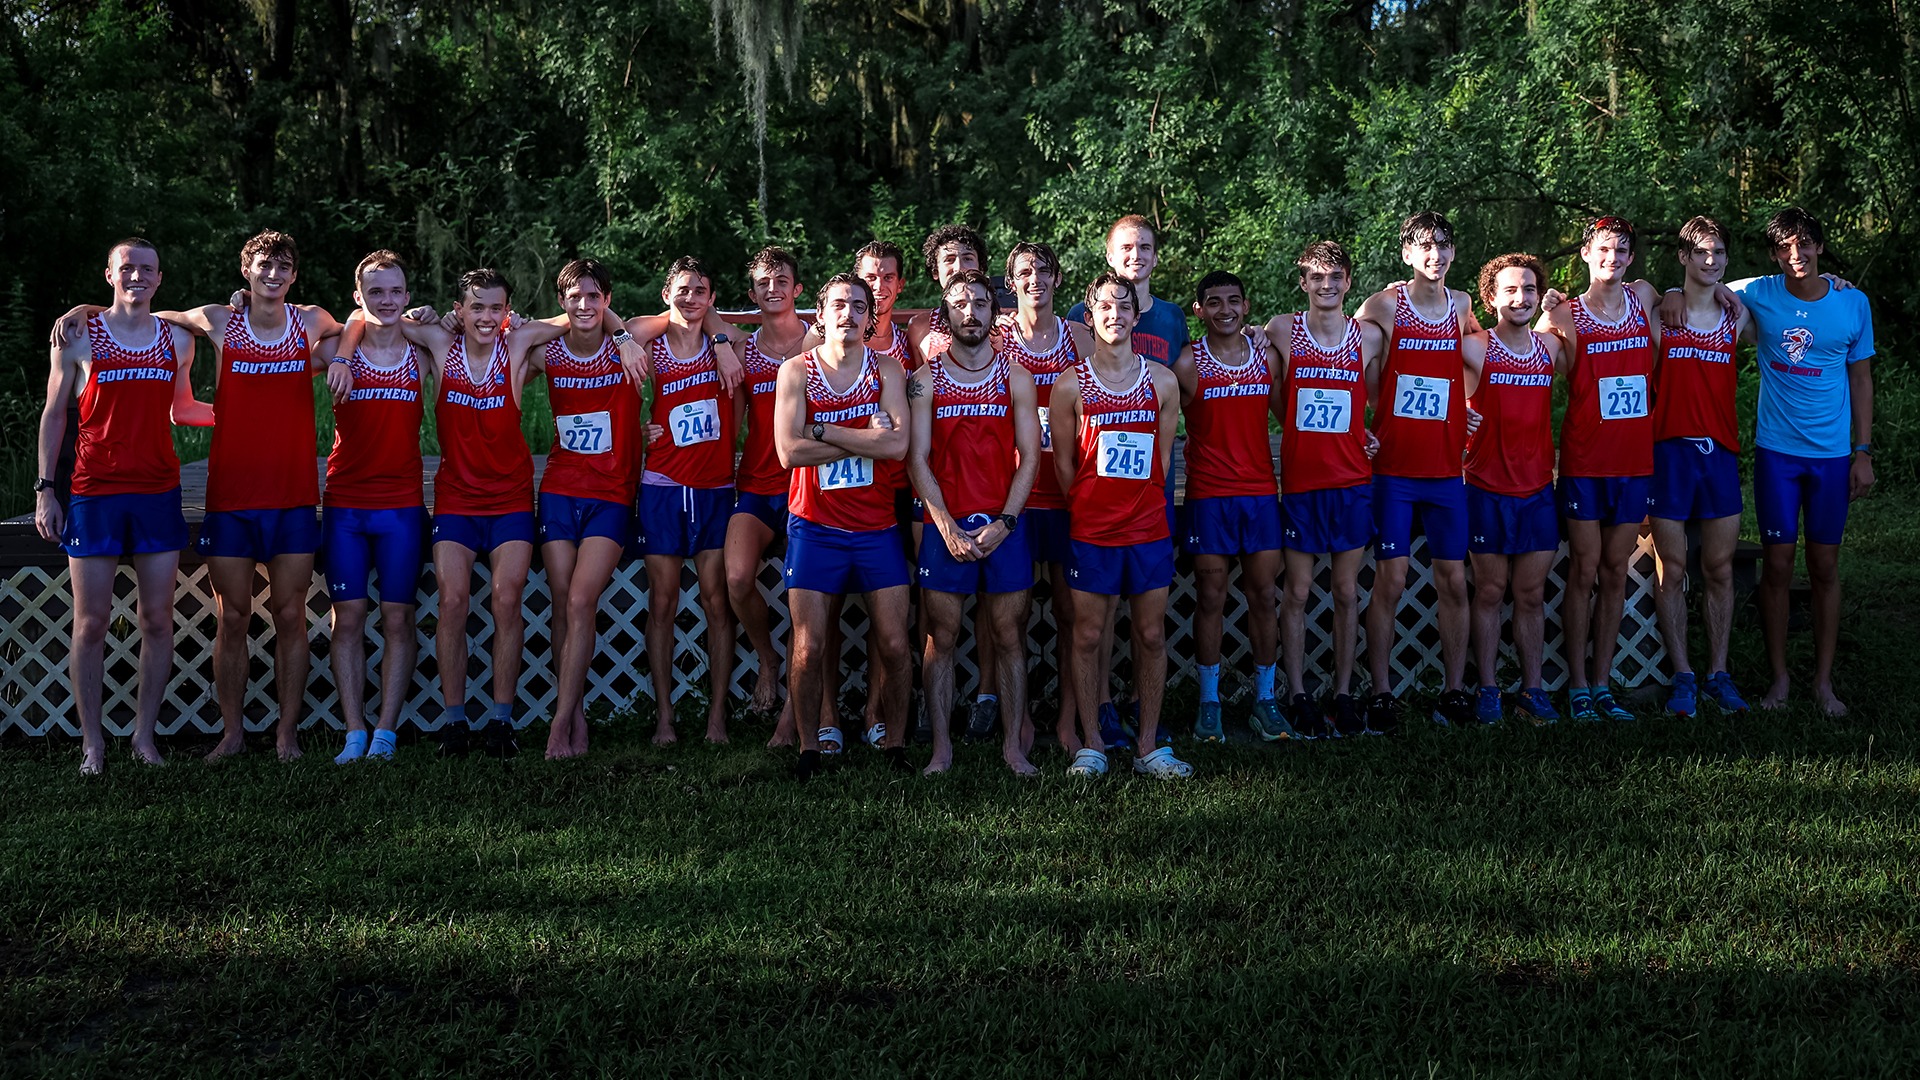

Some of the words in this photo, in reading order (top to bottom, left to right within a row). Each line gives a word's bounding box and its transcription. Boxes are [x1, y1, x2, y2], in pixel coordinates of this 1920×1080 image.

[1398, 338, 1458, 351] SOUTHER
[1587, 336, 1648, 354] SOUTHERN
[1668, 347, 1731, 364] SOUTHERN
[231, 359, 306, 374] SOUTHERN
[1295, 367, 1359, 382] SOUTHERN
[97, 367, 174, 385] SOUTHERN
[553, 372, 624, 389] SOUTHERN
[662, 370, 720, 396] SOUTHER
[1490, 373, 1551, 387] SOUTHERN
[349, 387, 417, 402] SOUTHERN
[446, 390, 505, 410] SOUTHERN
[1203, 384, 1270, 400] SOUTHERN
[936, 404, 1007, 419] SOUTHERN
[1402, 390, 1441, 417] 243
[1607, 391, 1641, 416] 232
[1090, 410, 1156, 427] SOUTHERN
[1303, 404, 1342, 429] 237
[677, 415, 714, 443] 244
[565, 427, 603, 451] 227
[1105, 447, 1145, 476] 245
[826, 458, 864, 485] 241
